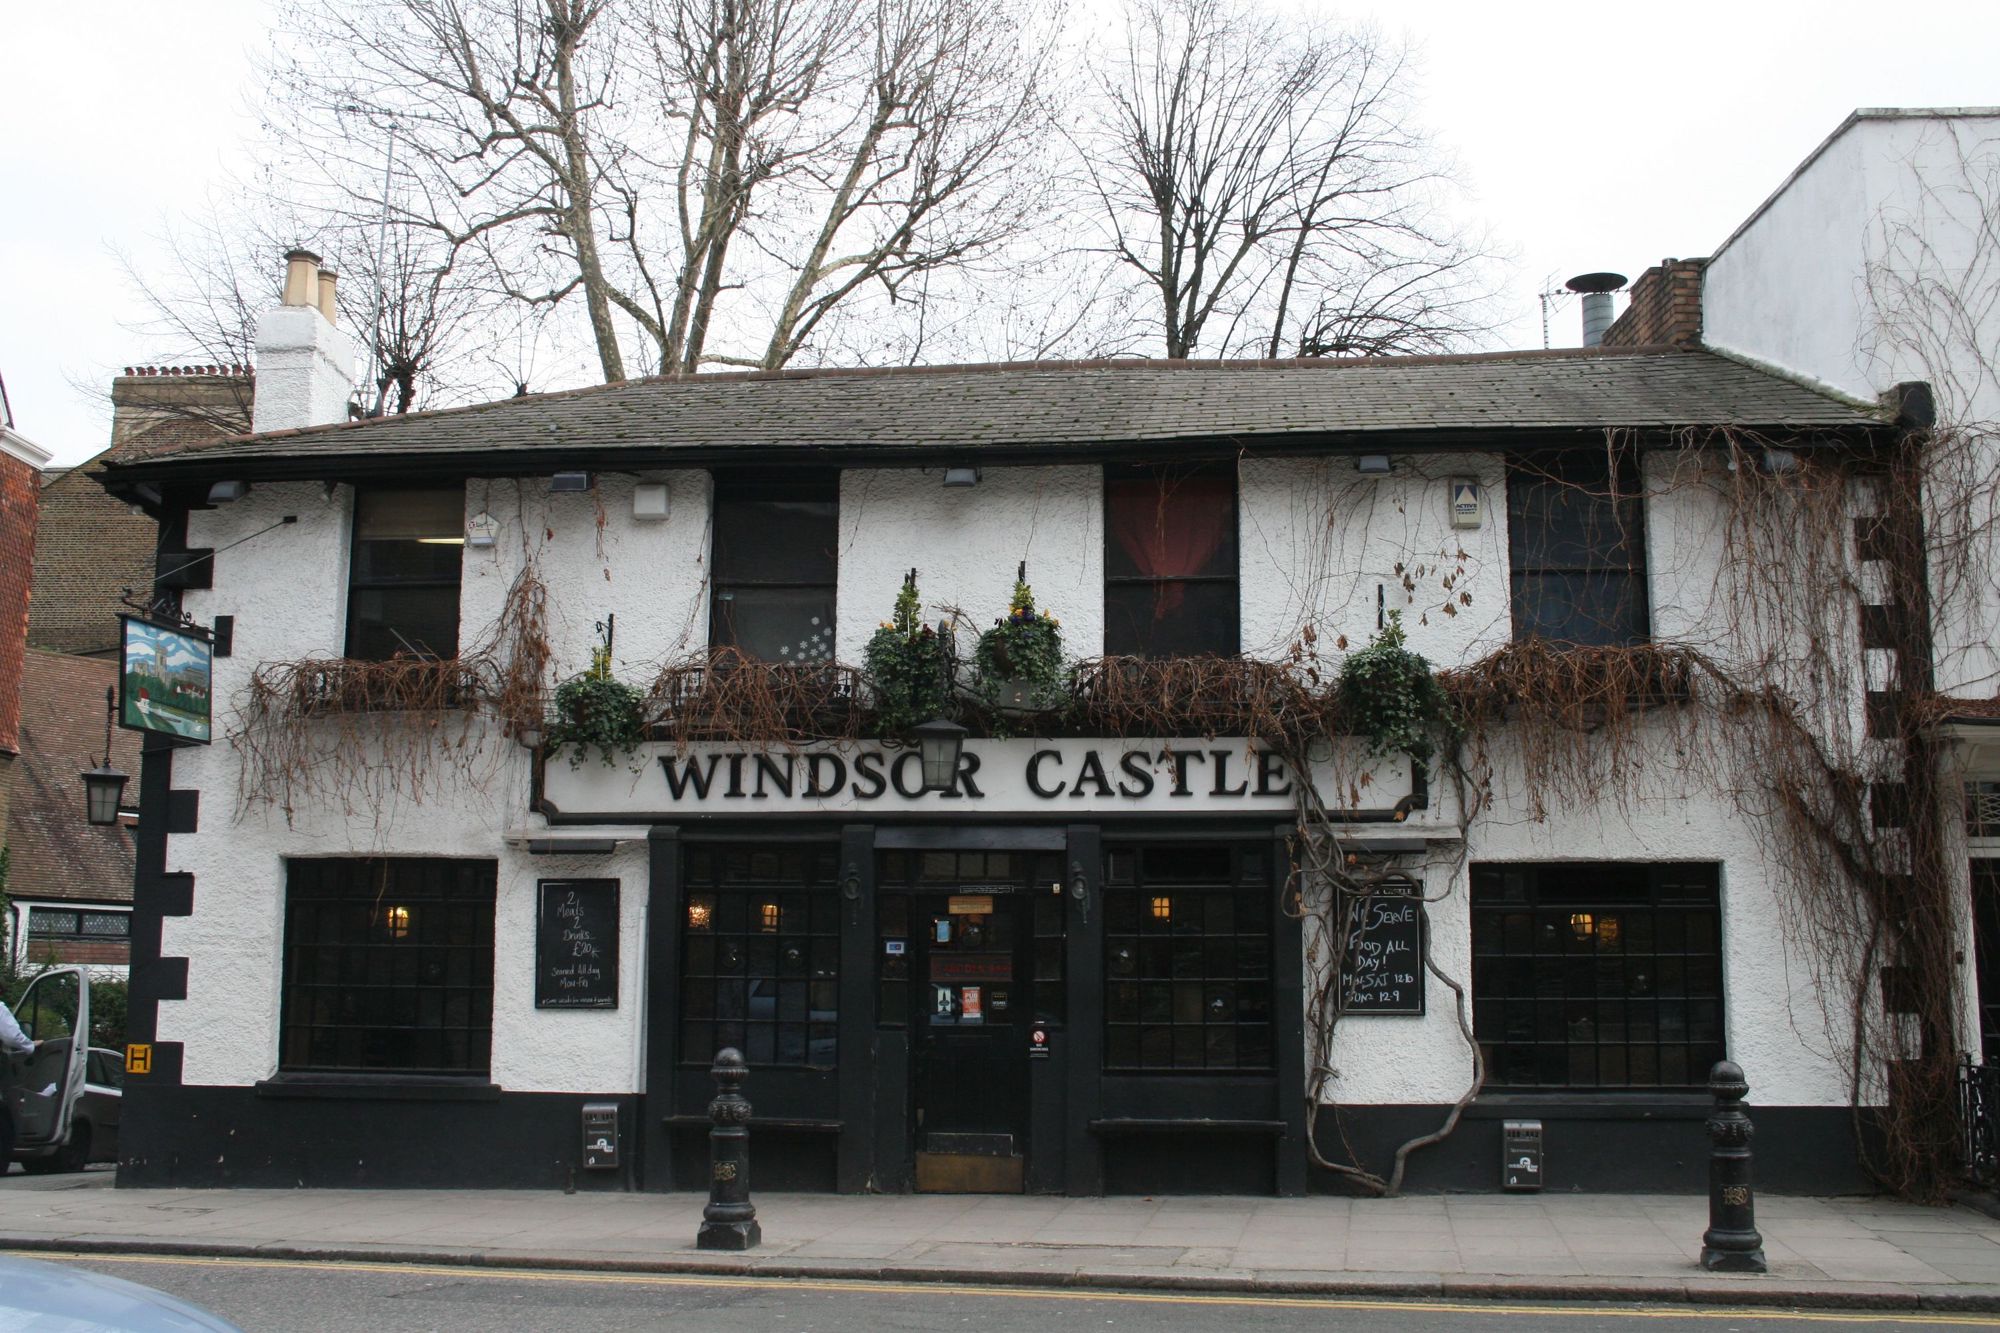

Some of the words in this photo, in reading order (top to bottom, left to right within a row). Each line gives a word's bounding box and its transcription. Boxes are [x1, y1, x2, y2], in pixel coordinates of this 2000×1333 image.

[657, 752, 985, 800] WINDSOR
[1026, 749, 1292, 798] CASTLE
[567, 891, 576, 905] 2
[557, 899, 584, 918] Meals
[1366, 903, 1414, 930] SERVE
[573, 916, 582, 929] 2
[563, 929, 591, 941] Drinks
[1386, 940, 1410, 954] ALL
[130, 1048, 148, 1070] H
